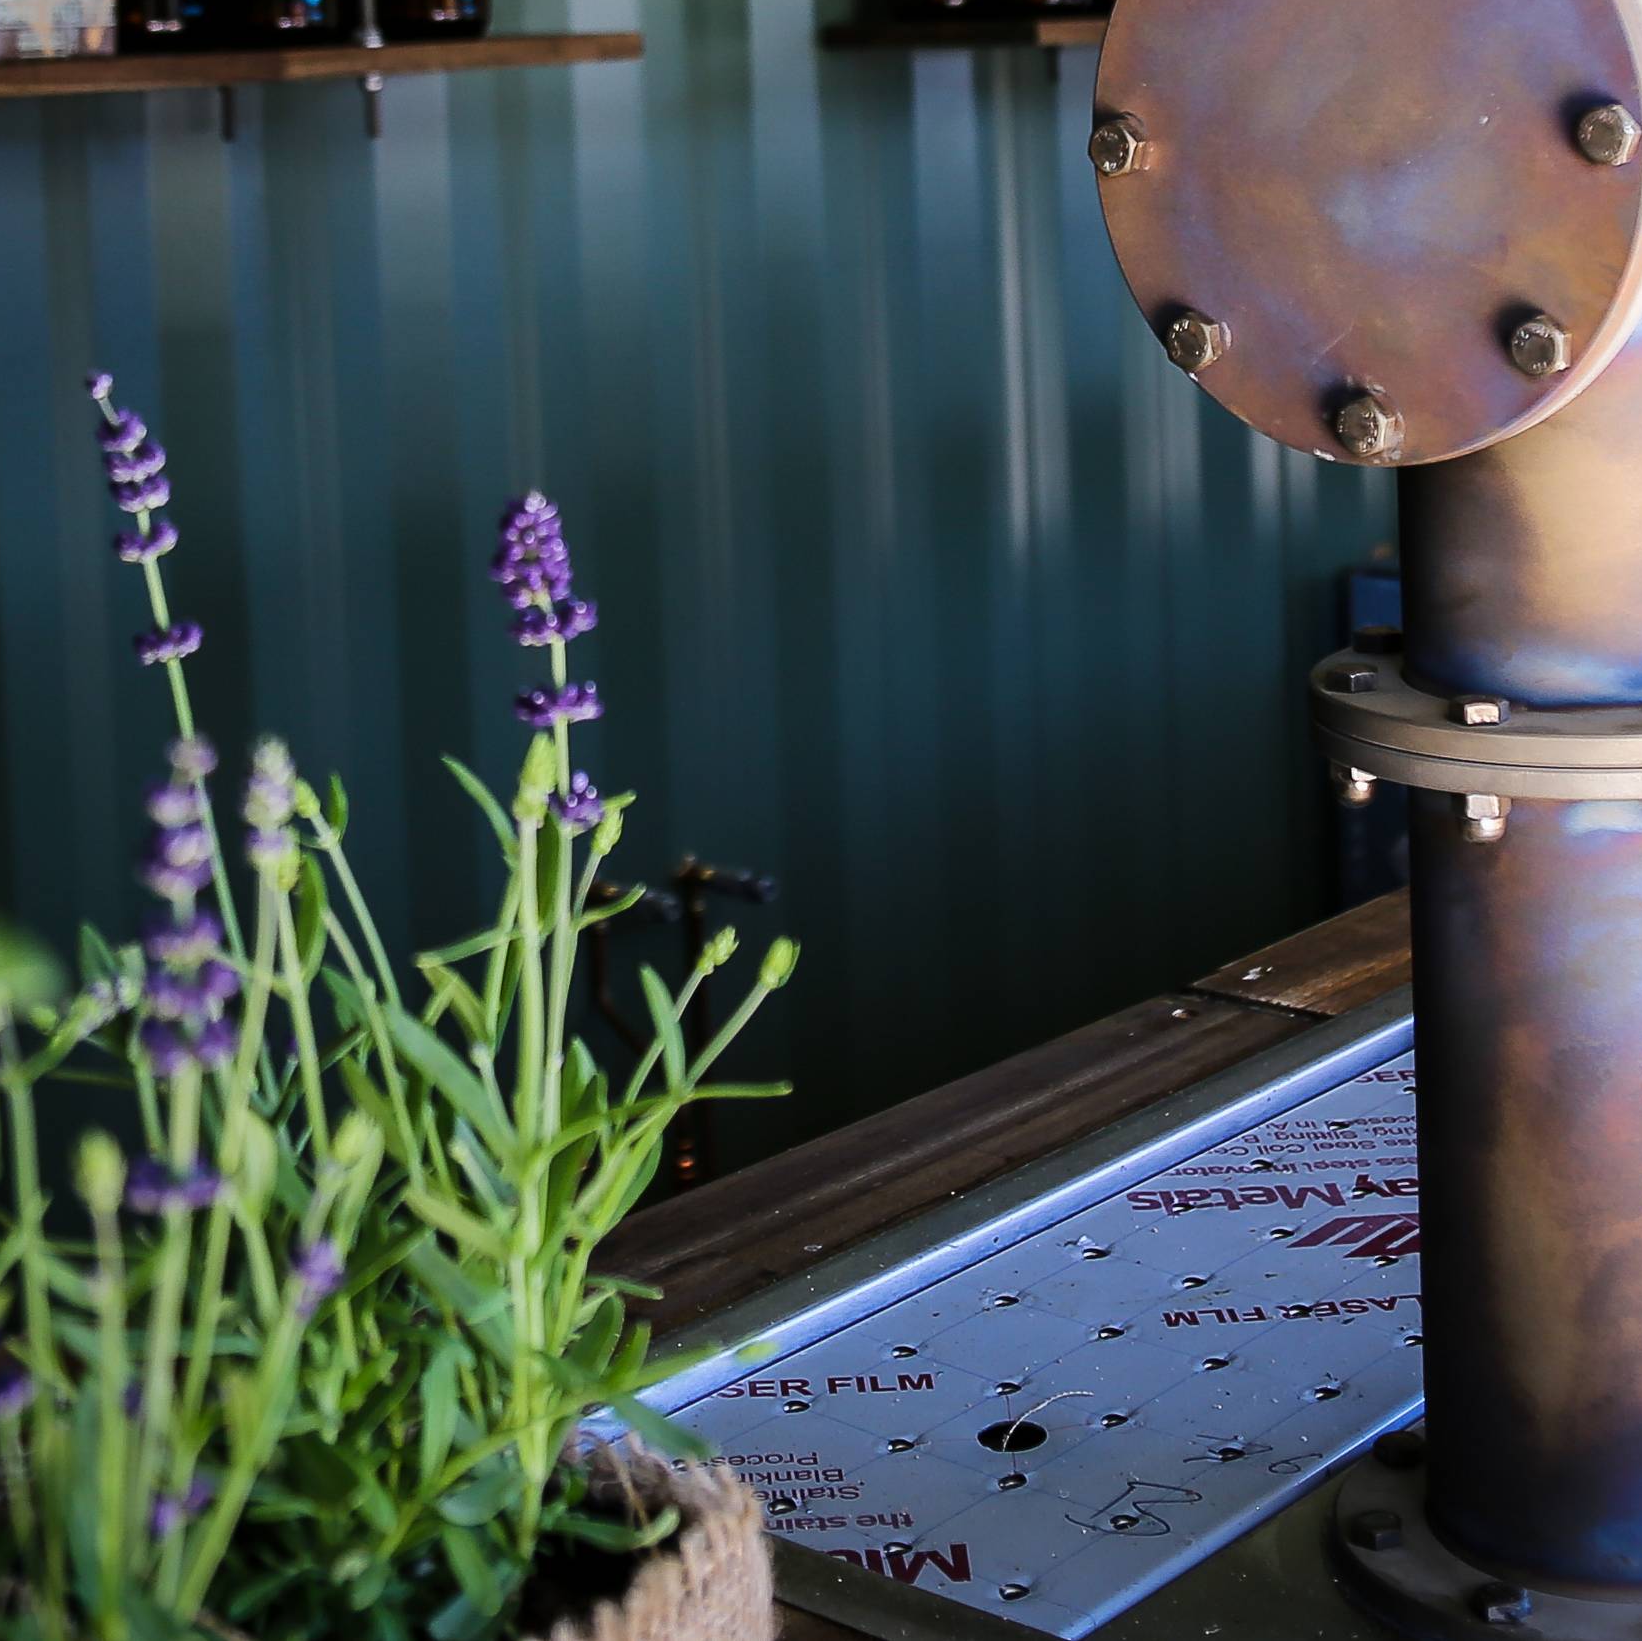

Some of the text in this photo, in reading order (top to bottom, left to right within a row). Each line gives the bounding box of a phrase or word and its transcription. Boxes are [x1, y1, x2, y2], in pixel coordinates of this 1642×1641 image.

[1313, 1139, 1377, 1152] Steel
[1302, 1159, 1371, 1172] steel
[1126, 1182, 1347, 1216] Metals
[1162, 1305, 1268, 1328] FILM
[716, 1373, 935, 1399] SER FILM
[855, 1512, 914, 1530] the
